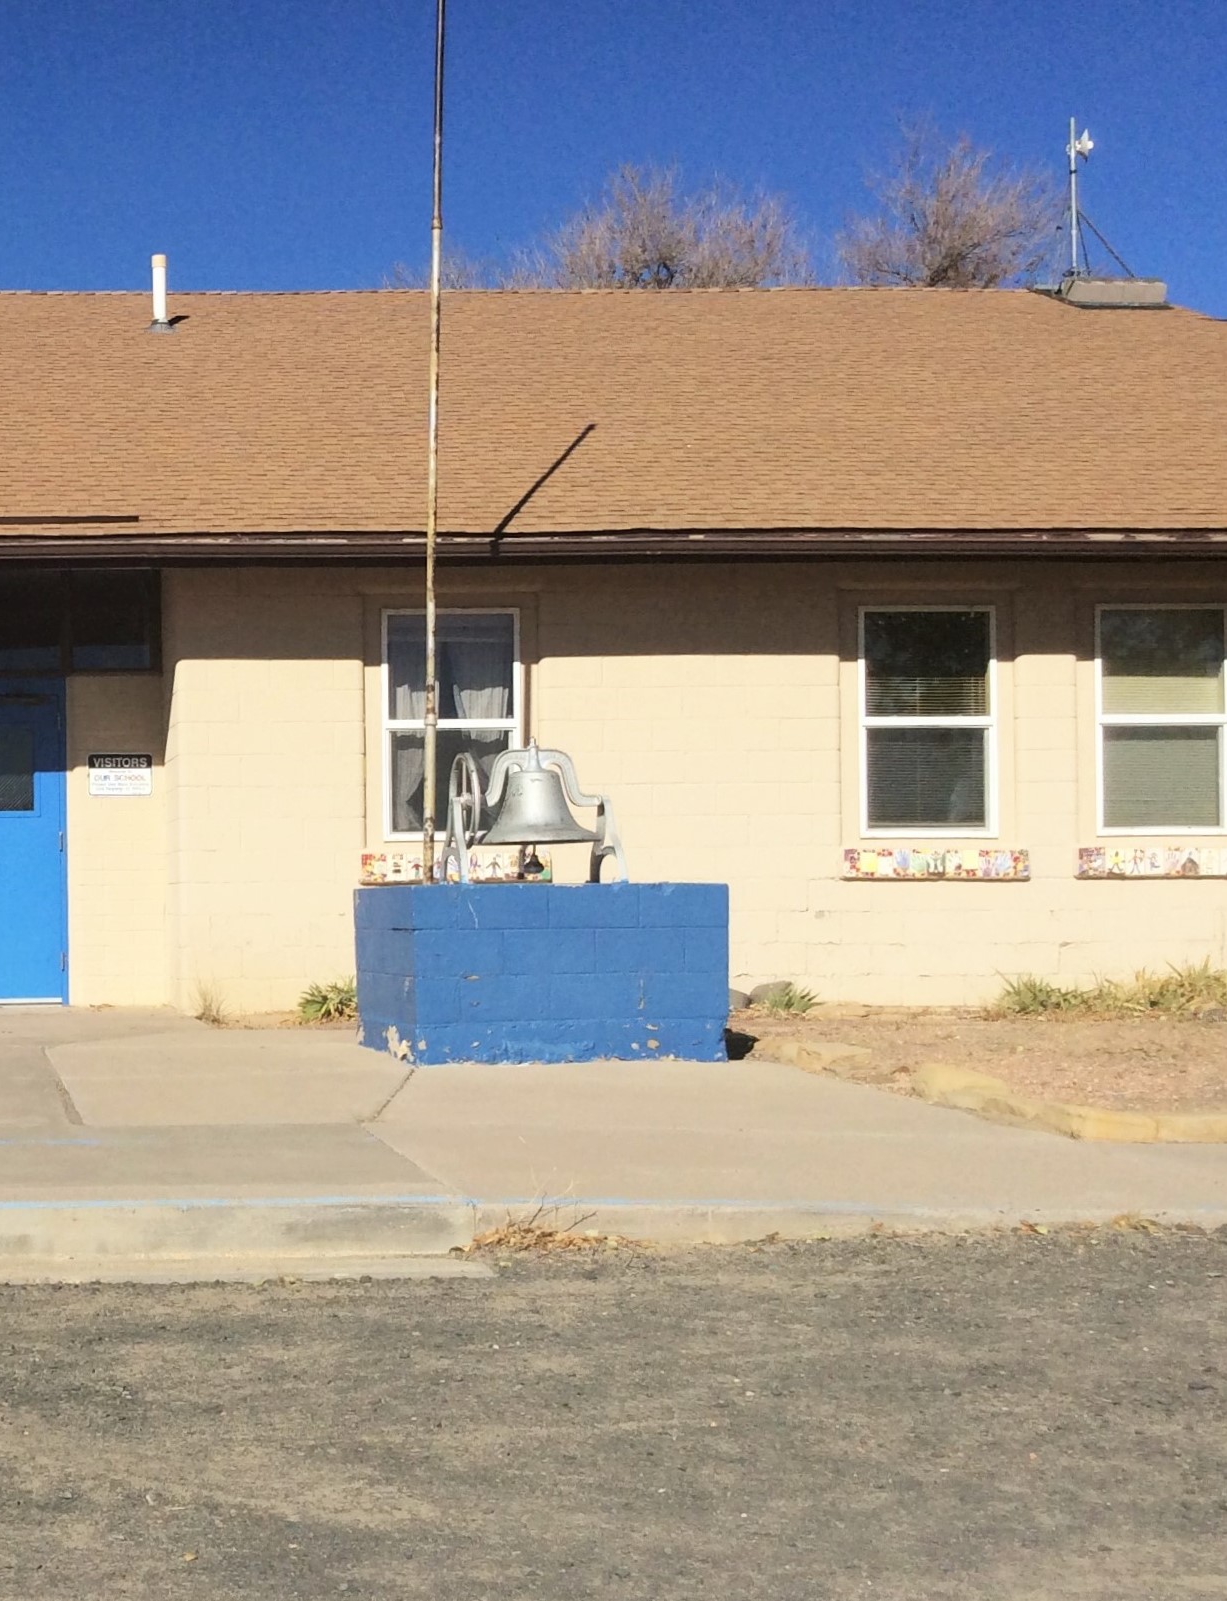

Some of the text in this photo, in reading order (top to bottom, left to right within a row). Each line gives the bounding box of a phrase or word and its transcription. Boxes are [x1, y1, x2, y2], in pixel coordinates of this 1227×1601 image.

[92, 756, 148, 768] VISITORS
[93, 774, 147, 782] OUR SCHOOL
